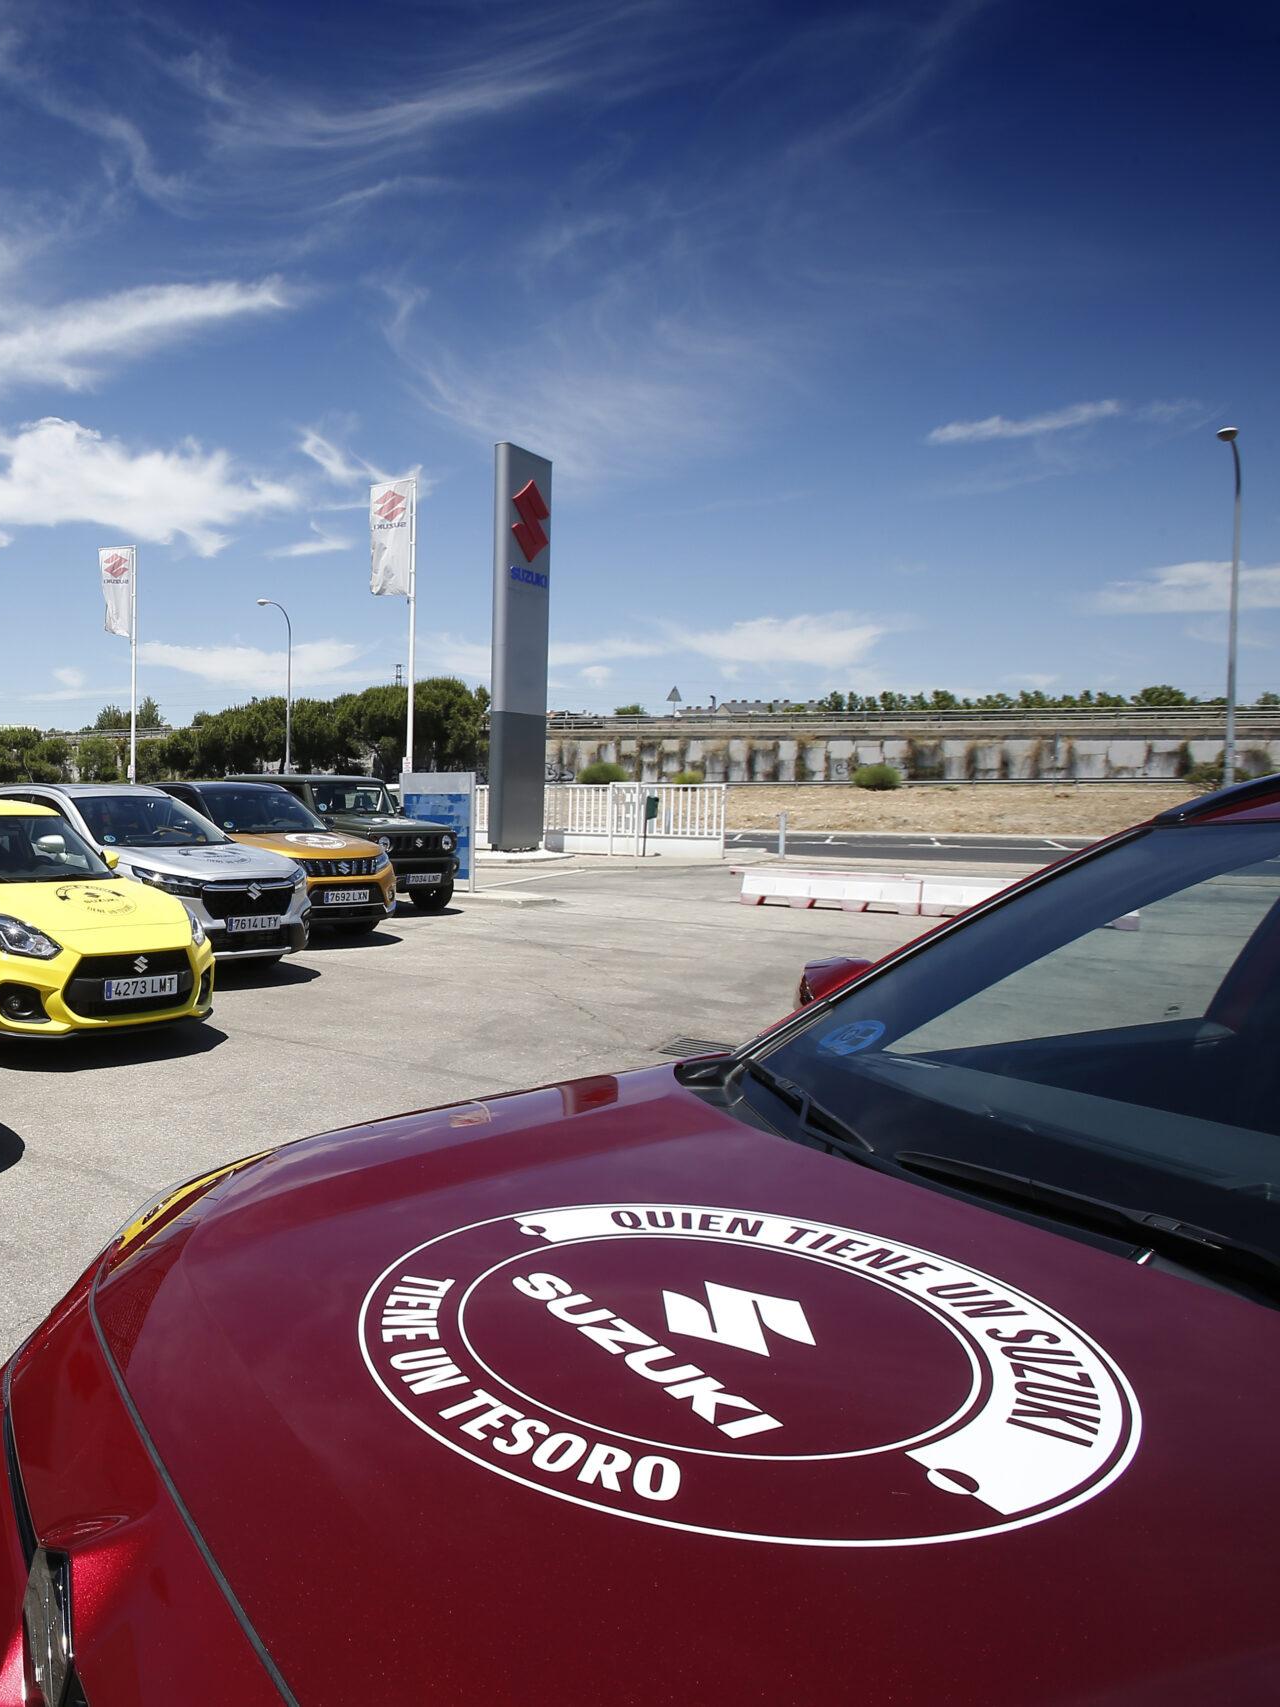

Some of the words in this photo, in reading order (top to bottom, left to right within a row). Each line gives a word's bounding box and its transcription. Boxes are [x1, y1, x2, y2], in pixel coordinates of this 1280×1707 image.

[510, 566, 548, 589] SUZUKI
[330, 892, 350, 902] 7692
[352, 890, 368, 901] LXN
[234, 918, 258, 930] 7614
[260, 916, 278, 929] LTY
[114, 980, 147, 997] 4273
[151, 977, 175, 994] LMT
[380, 1275, 456, 1343] TIENE
[610, 1210, 764, 1238] QUIEN
[782, 1226, 943, 1281] TIENE
[926, 1281, 1029, 1319] UN
[985, 1328, 1102, 1449] SUZUKI
[389, 1346, 472, 1396] UN
[511, 1272, 785, 1440] SUZUKI
[437, 1387, 682, 1502] TESORO
